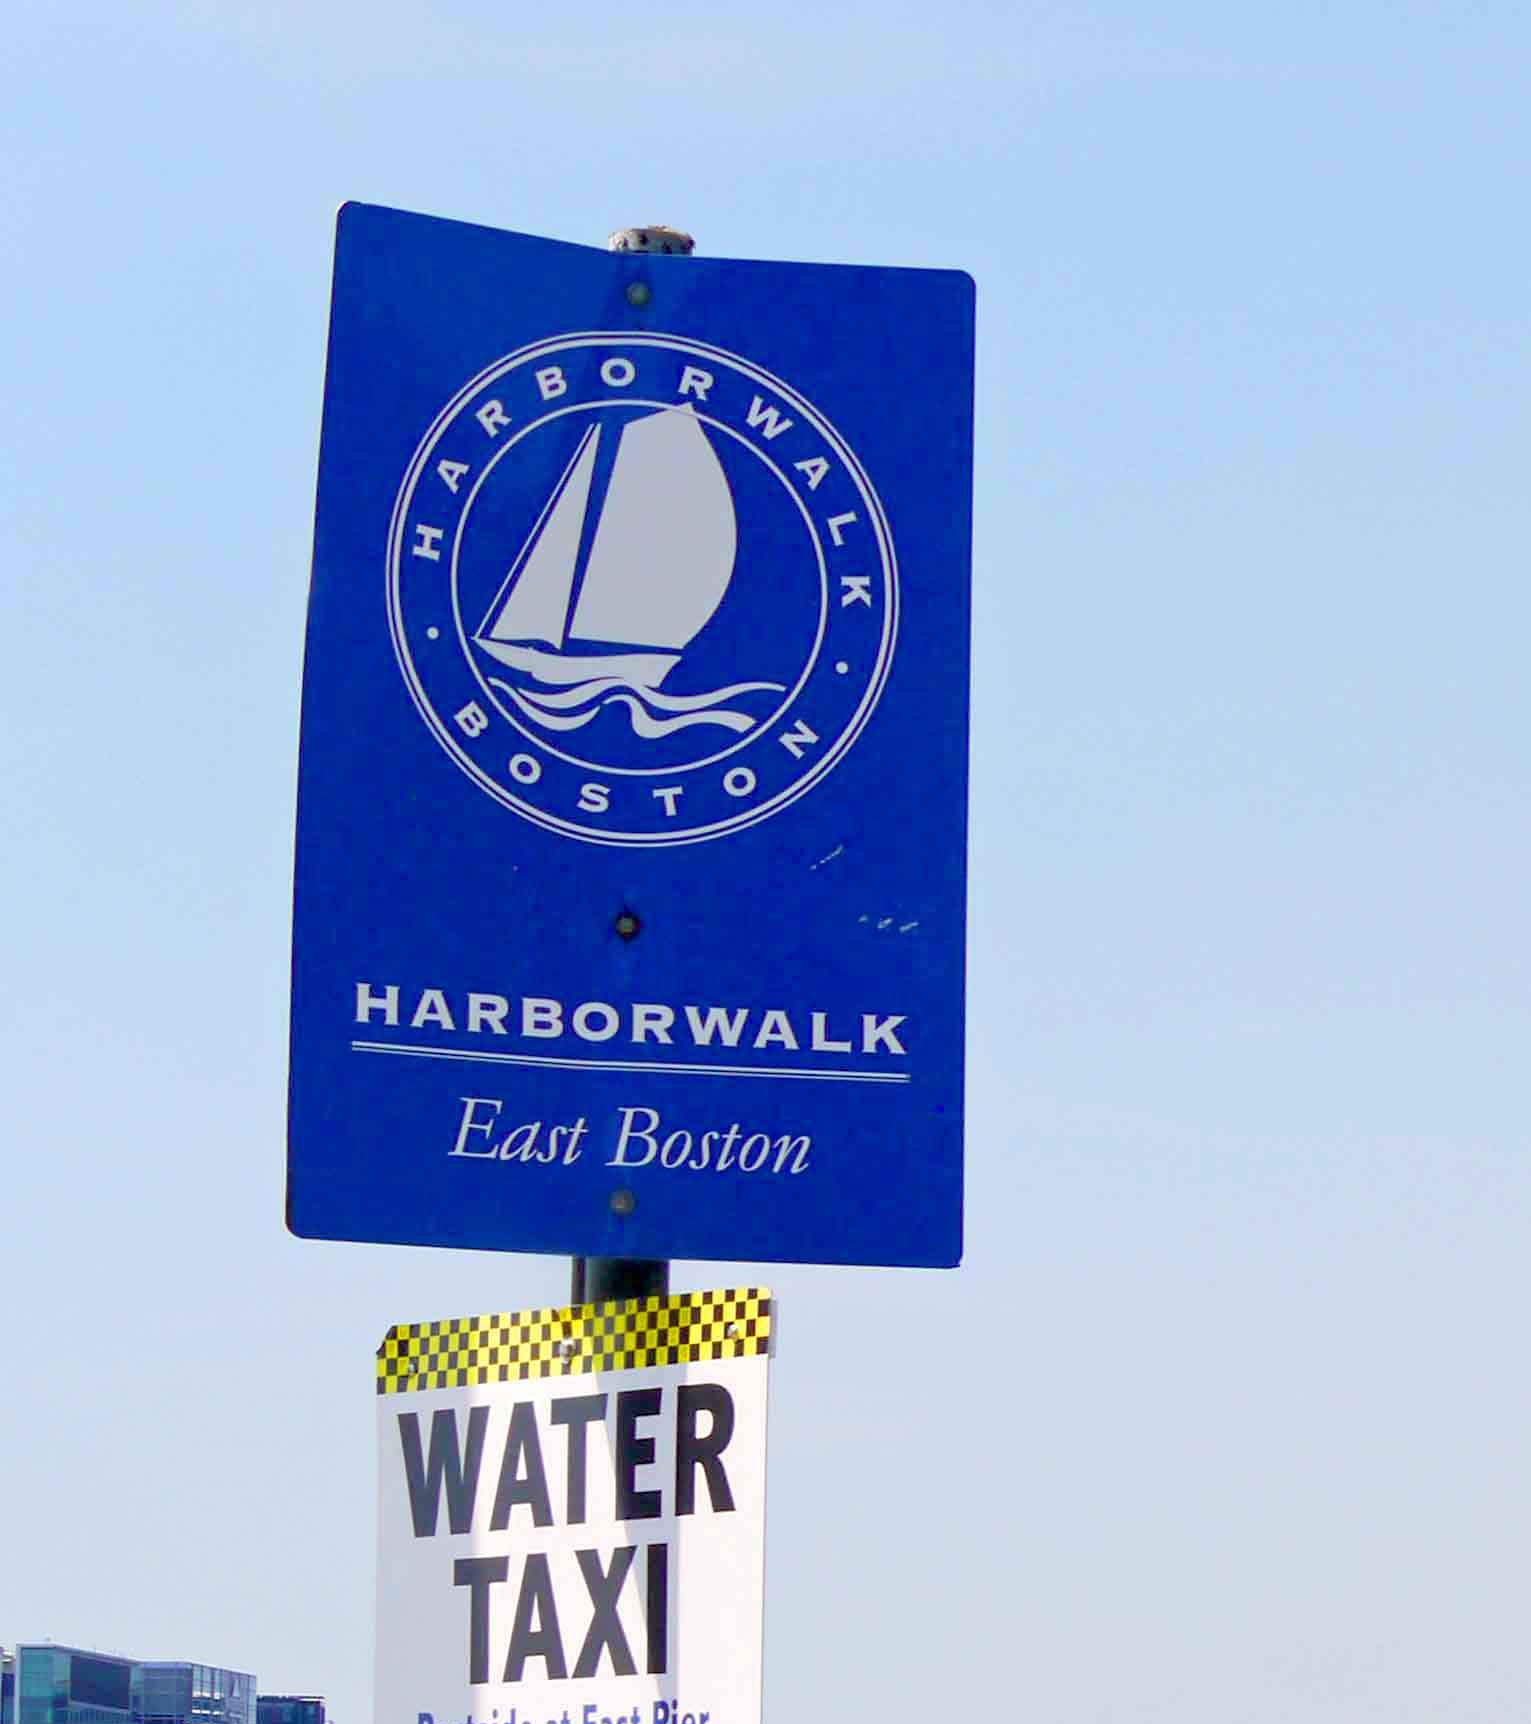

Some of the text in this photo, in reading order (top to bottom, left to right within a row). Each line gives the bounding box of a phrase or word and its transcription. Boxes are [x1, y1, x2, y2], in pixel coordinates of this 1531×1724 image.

[412, 358, 872, 608] HARBORWALK
[453, 700, 820, 817] BOSTON
[353, 983, 907, 1055] HARBORWALK
[448, 1097, 811, 1174] East Boston
[397, 1383, 737, 1538] WATER
[453, 1542, 668, 1685] TAXI
